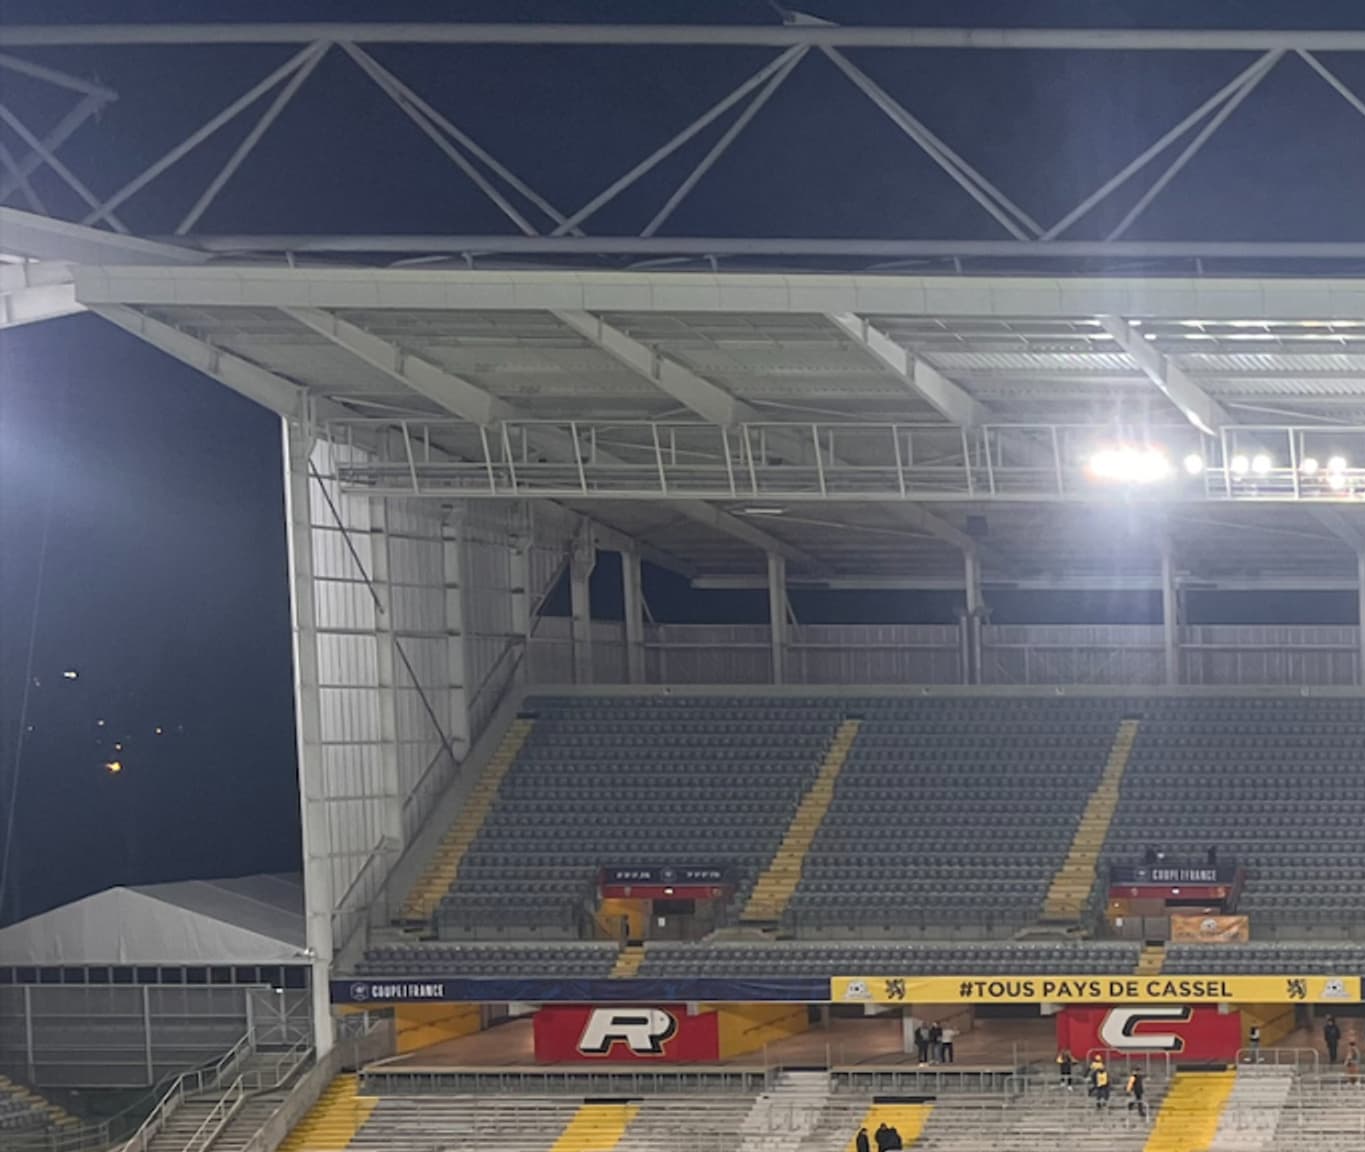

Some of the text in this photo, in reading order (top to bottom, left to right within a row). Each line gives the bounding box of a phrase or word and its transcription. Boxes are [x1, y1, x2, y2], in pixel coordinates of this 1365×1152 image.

[960, 980, 1233, 998] #TOUS PAYS DE CASSEL
[577, 1007, 677, 1055] R
[1100, 1004, 1194, 1052] C
